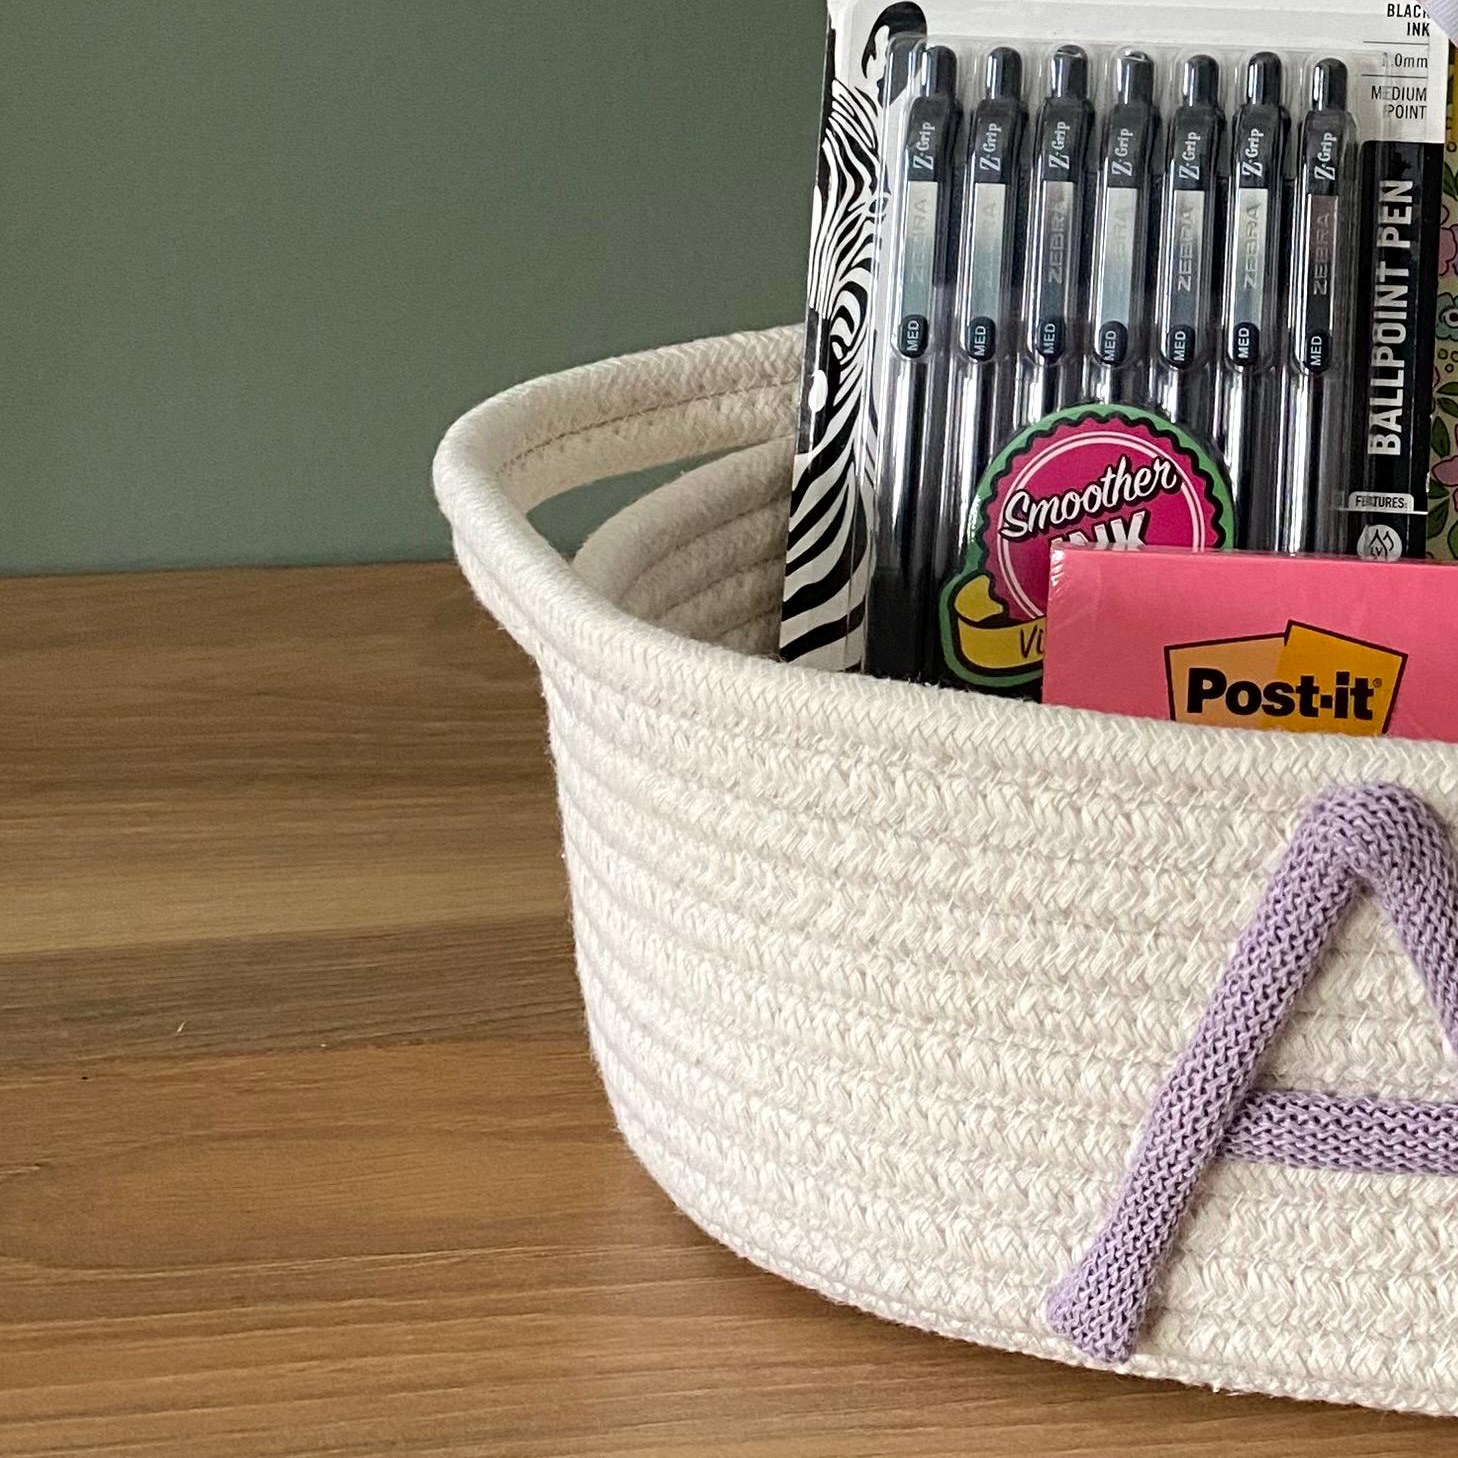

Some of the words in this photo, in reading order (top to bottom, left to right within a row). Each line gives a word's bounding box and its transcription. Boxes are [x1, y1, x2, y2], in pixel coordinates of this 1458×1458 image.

[1407, 22, 1430, 37] INK
[1371, 85, 1427, 101] MEDIUM
[1383, 104, 1427, 119] POINT
[1376, 179, 1413, 248] PEN
[1314, 212, 1330, 295] ZEBRA
[907, 319, 918, 351] MED
[974, 325, 986, 356] MED
[1043, 322, 1055, 354] MED
[1104, 330, 1116, 361] MED
[1174, 330, 1186, 361] MED
[1237, 326, 1249, 358] MED
[1311, 335, 1322, 366] MED
[1367, 260, 1409, 455] BALLPOINT
[1000, 455, 1177, 538] Smoother
